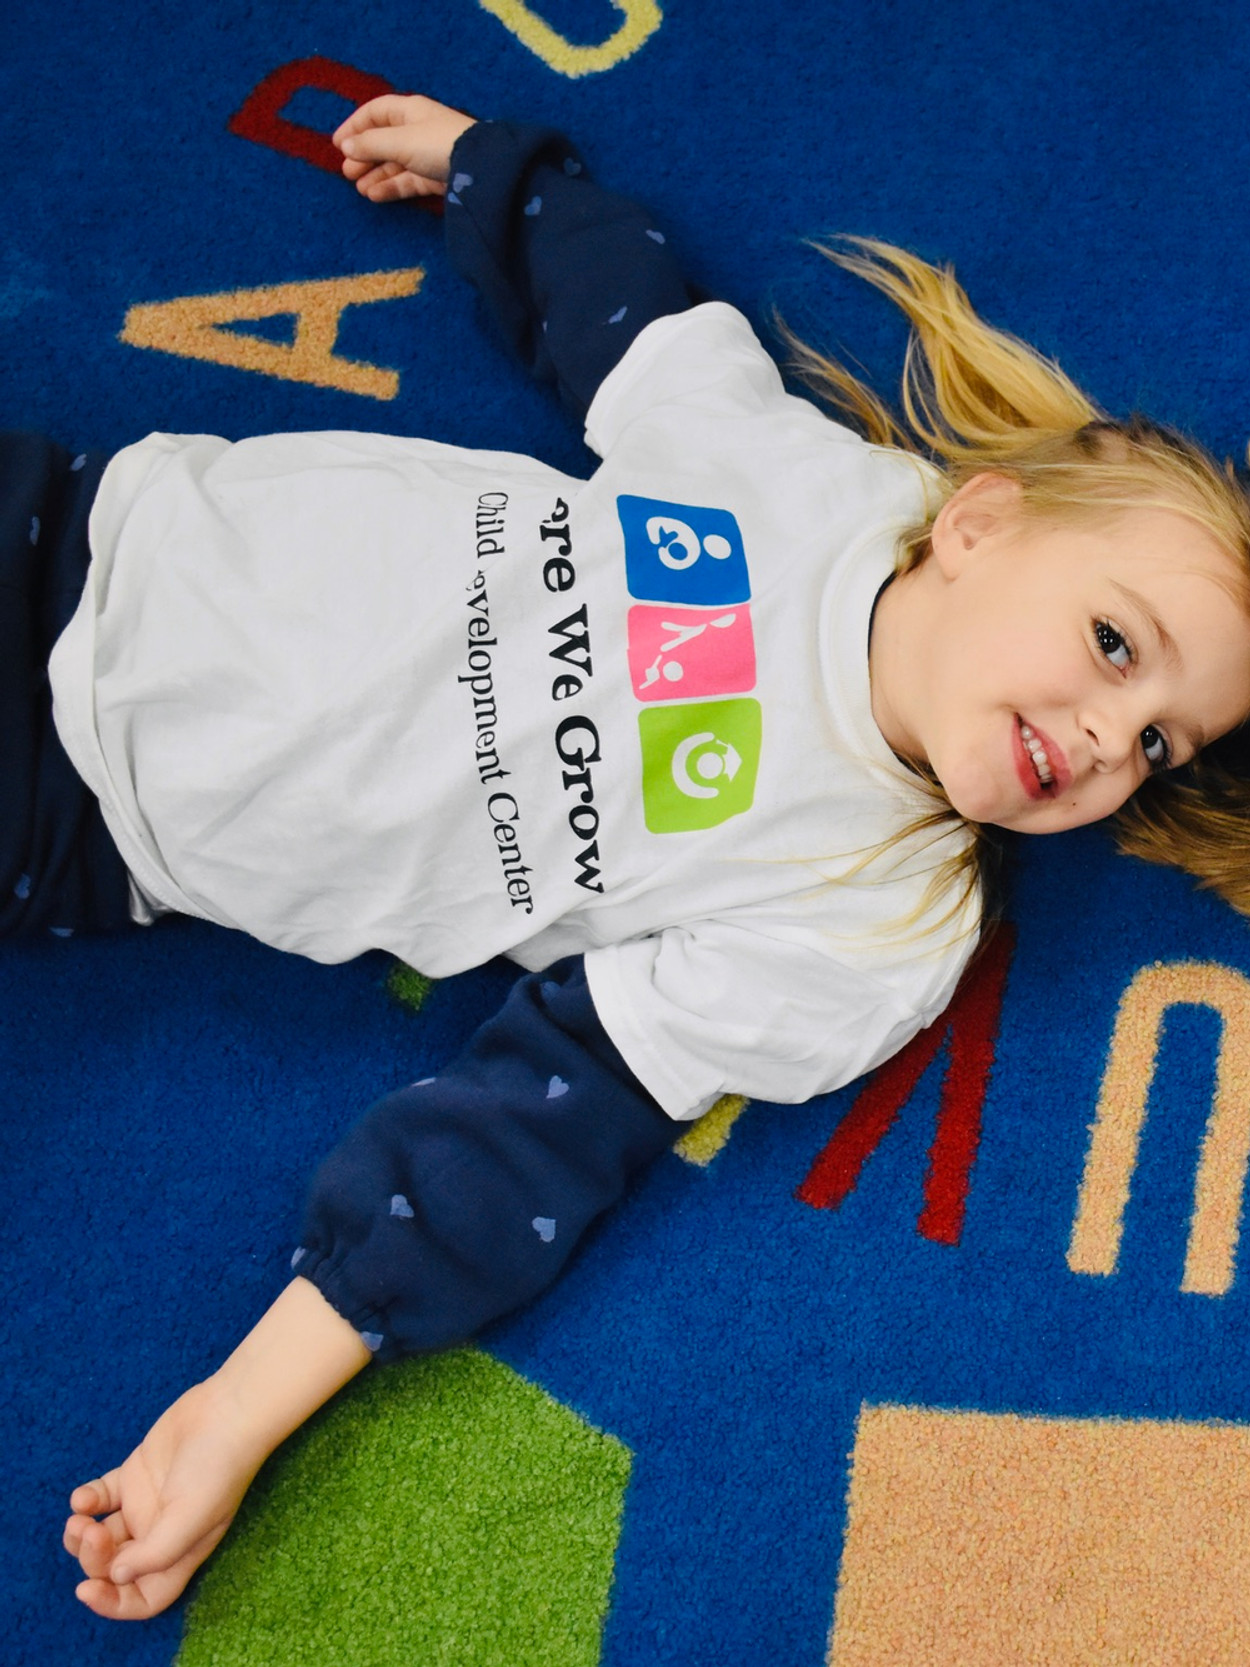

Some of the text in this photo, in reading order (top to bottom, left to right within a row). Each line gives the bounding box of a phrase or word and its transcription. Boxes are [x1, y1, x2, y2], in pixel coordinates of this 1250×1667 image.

[118, 266, 426, 402] A
[457, 491, 534, 915] Child evelopment Center
[547, 603, 593, 701] We
[555, 714, 605, 894] Grow
